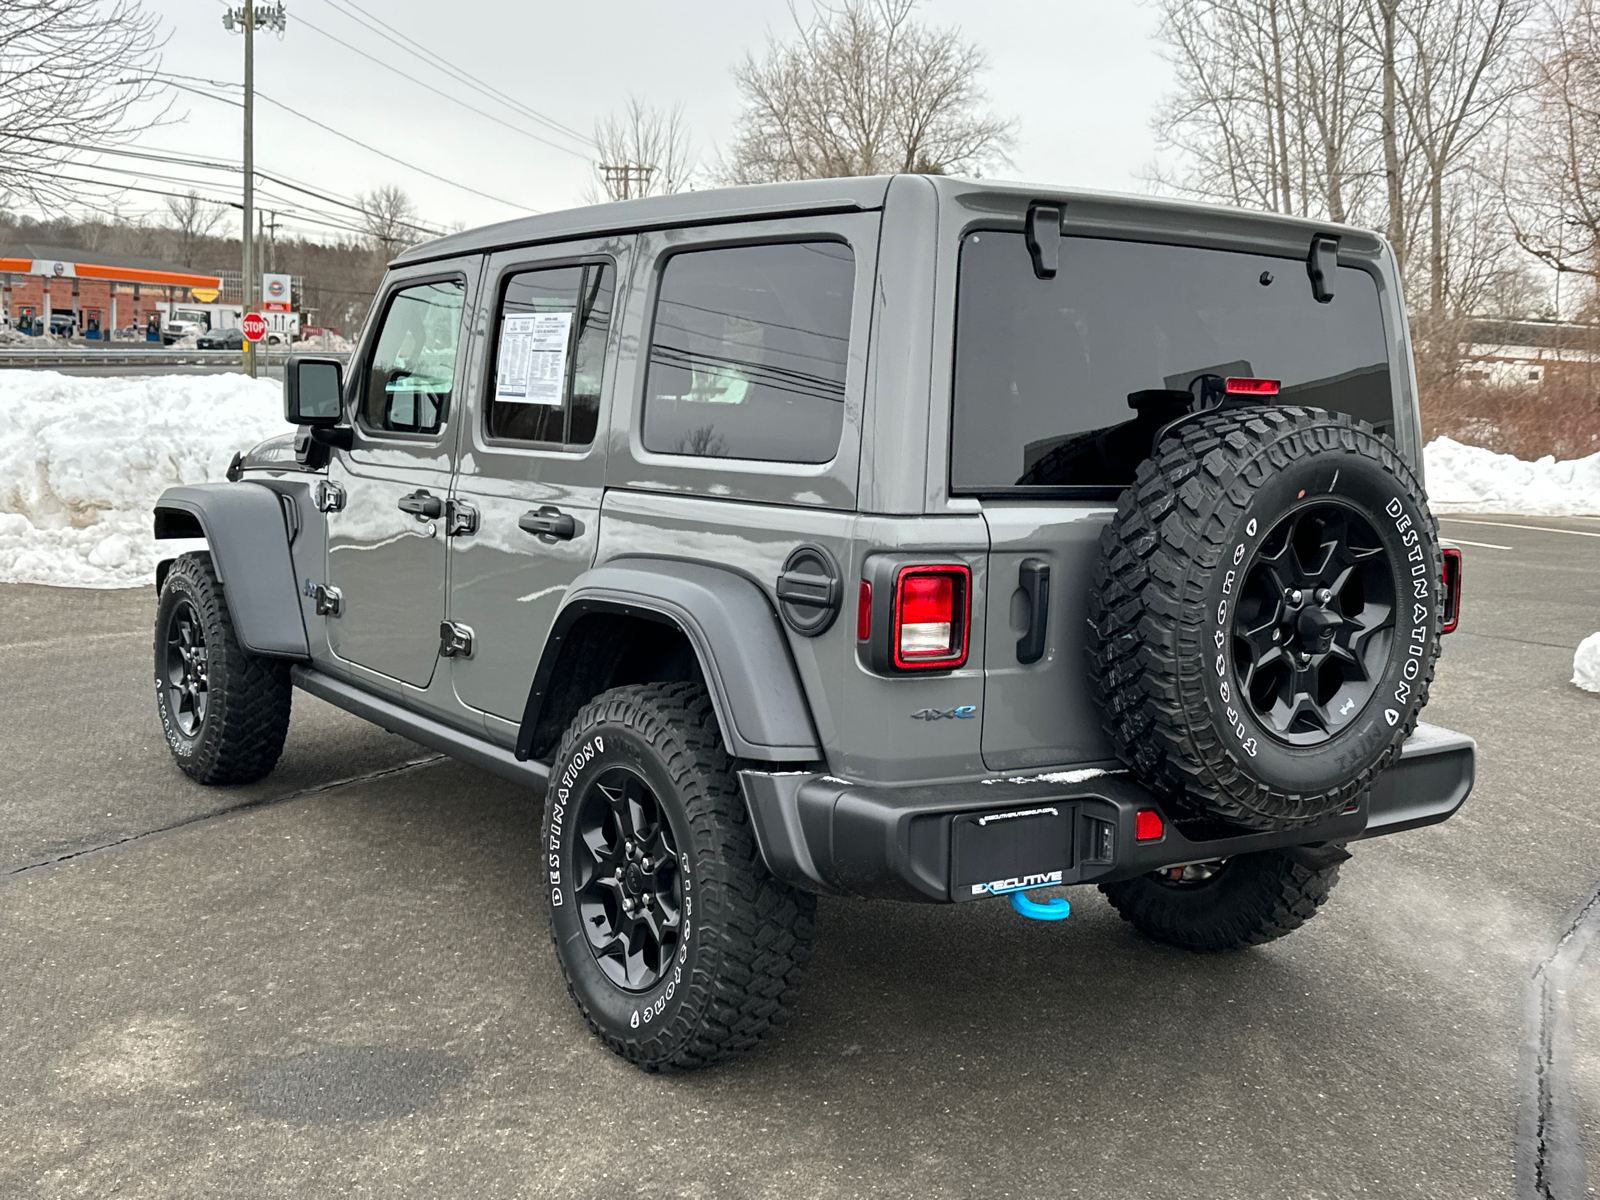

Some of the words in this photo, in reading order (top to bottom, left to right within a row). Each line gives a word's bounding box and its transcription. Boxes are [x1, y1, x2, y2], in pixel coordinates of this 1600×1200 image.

[243, 321, 264, 333] STOP
[1213, 543, 1258, 757] Firestone
[1385, 497, 1428, 705] DESTINATION
[549, 743, 595, 907] DESTINATION
[971, 871, 1062, 895] EXECUTIVE
[643, 853, 691, 1024] Firestone
